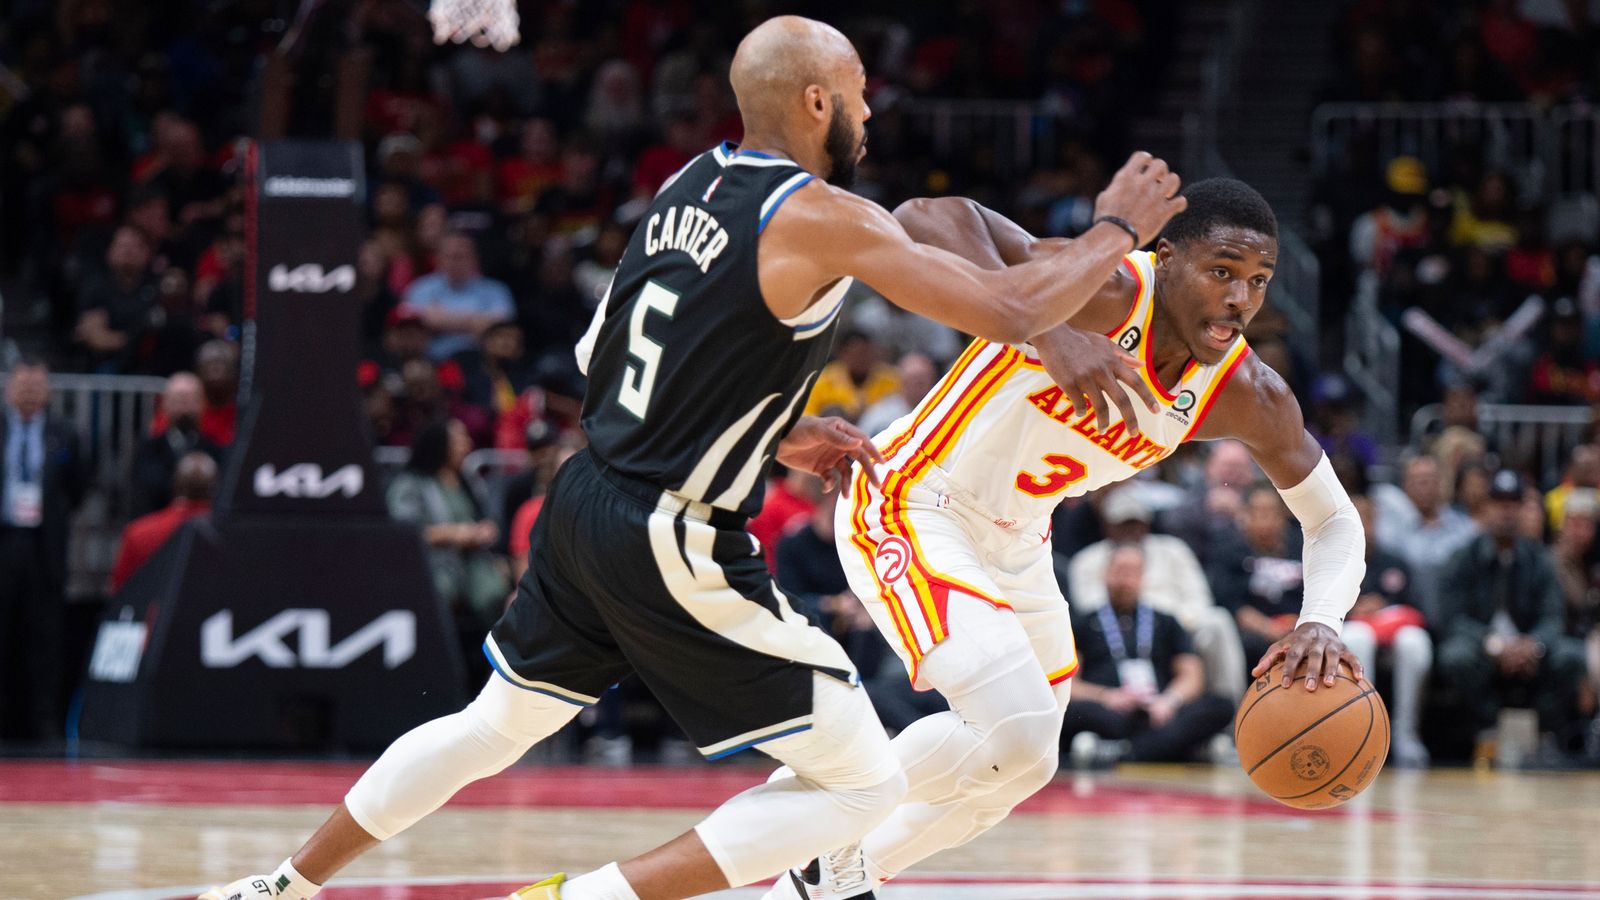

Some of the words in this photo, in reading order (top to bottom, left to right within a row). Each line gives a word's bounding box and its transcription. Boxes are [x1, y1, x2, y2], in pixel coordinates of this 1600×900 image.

[644, 204, 729, 274] CARTER
[617, 279, 682, 424] 5
[1122, 328, 1139, 350] 6
[1015, 453, 1088, 498] 3
[251, 880, 272, 897] GT
